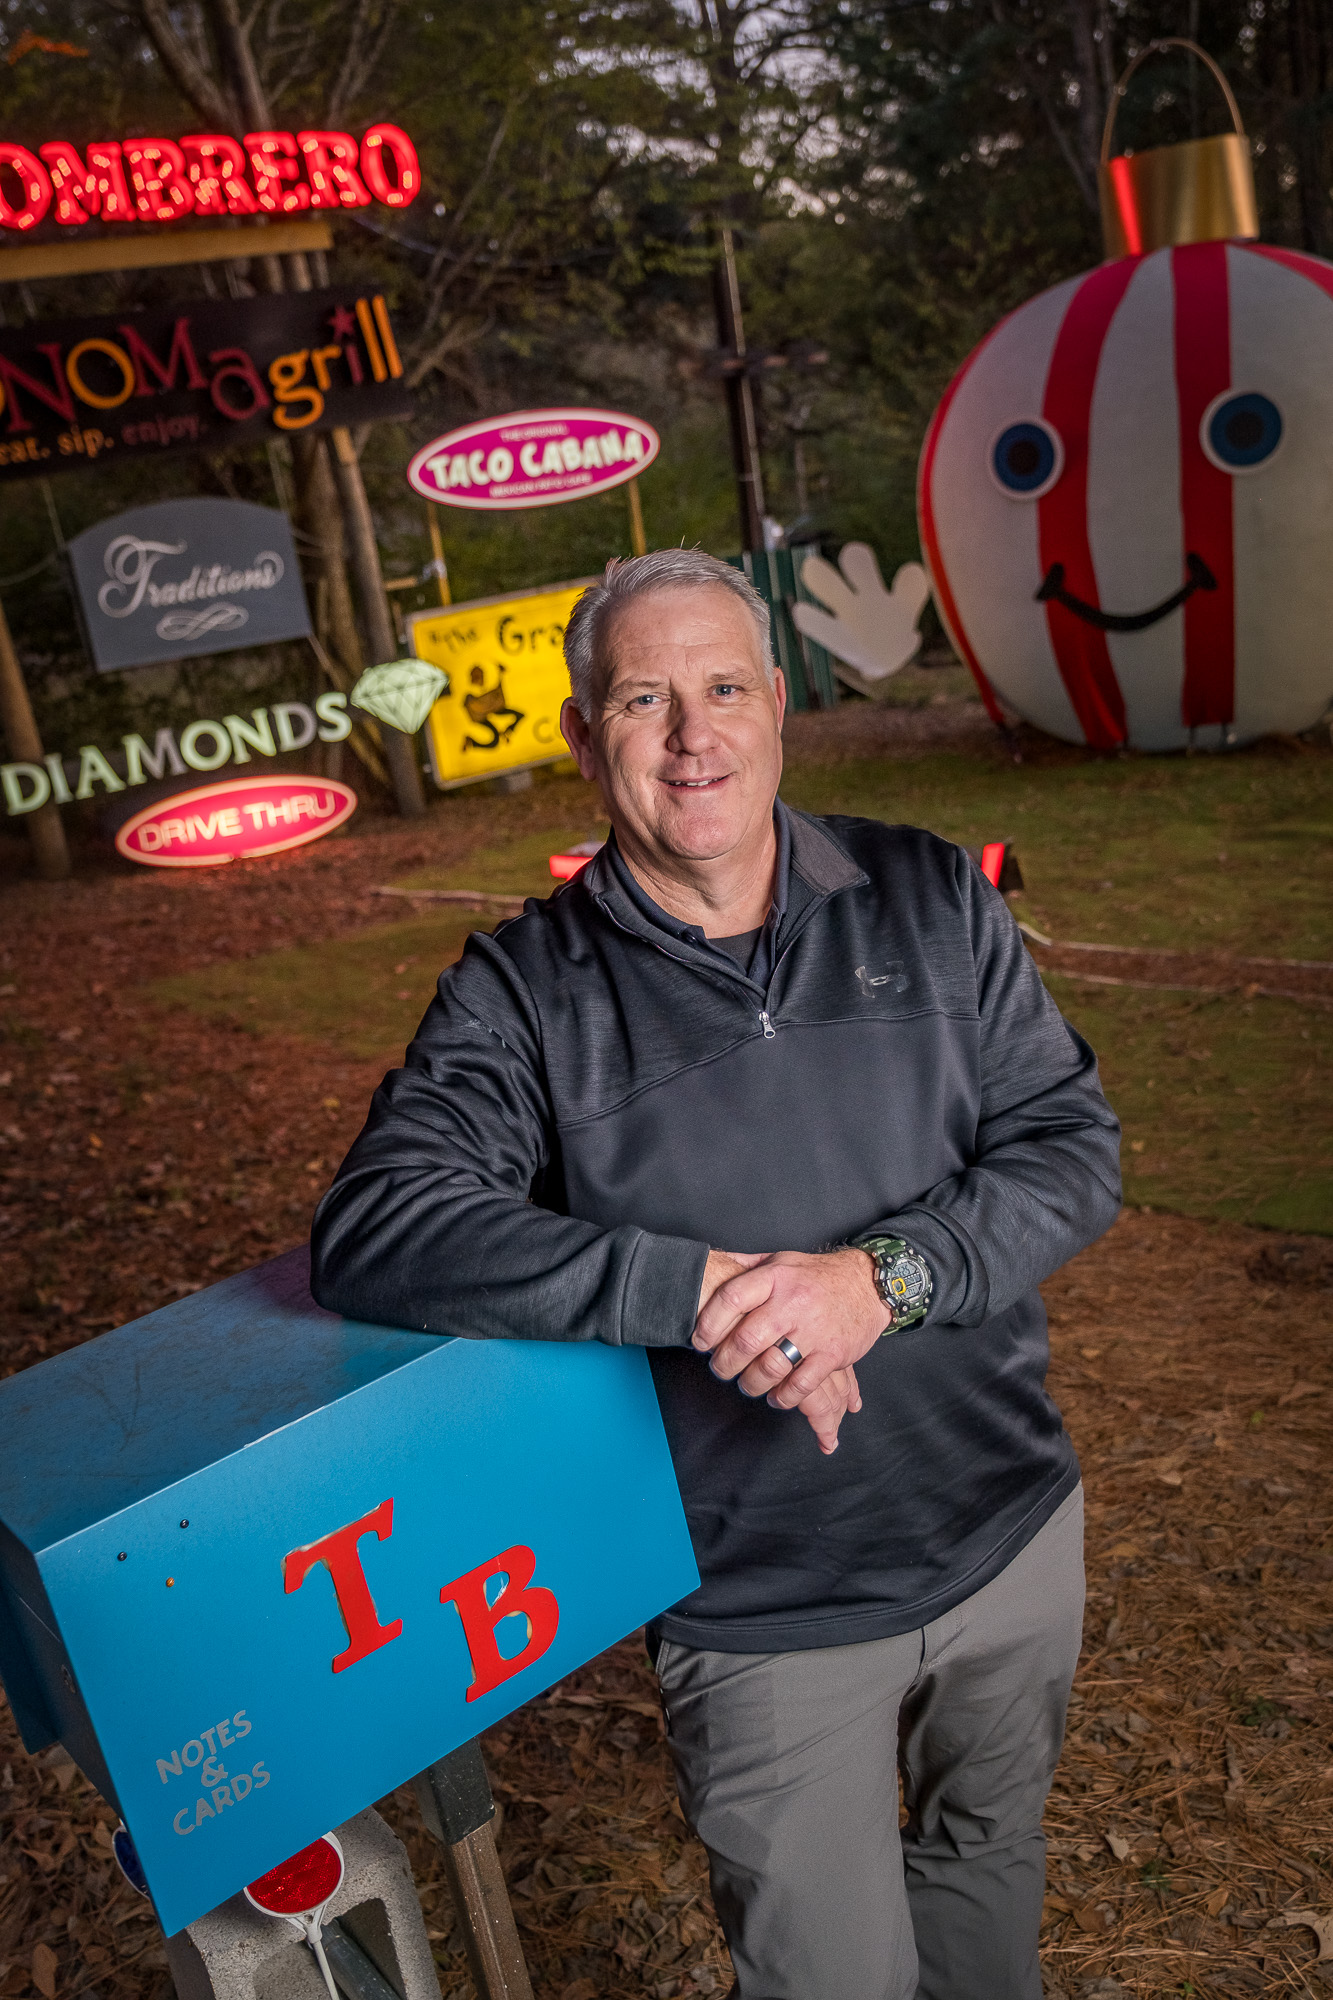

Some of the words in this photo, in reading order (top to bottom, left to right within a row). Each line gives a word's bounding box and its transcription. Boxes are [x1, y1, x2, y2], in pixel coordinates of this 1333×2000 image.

[0, 123, 421, 230] OMBRERO
[0, 317, 269, 433] NOMa
[57, 423, 115, 459] sip.
[426, 445, 514, 490] TACO
[519, 427, 644, 477] CABANA
[98, 534, 285, 618] Traditions
[1, 692, 352, 816] DIAMONDS
[137, 807, 245, 853] DRIVE
[243, 791, 337, 831] THRU
[155, 1709, 253, 1784] NOTES
[200, 1756, 229, 1787] &
[172, 1761, 271, 1836] CARDS
